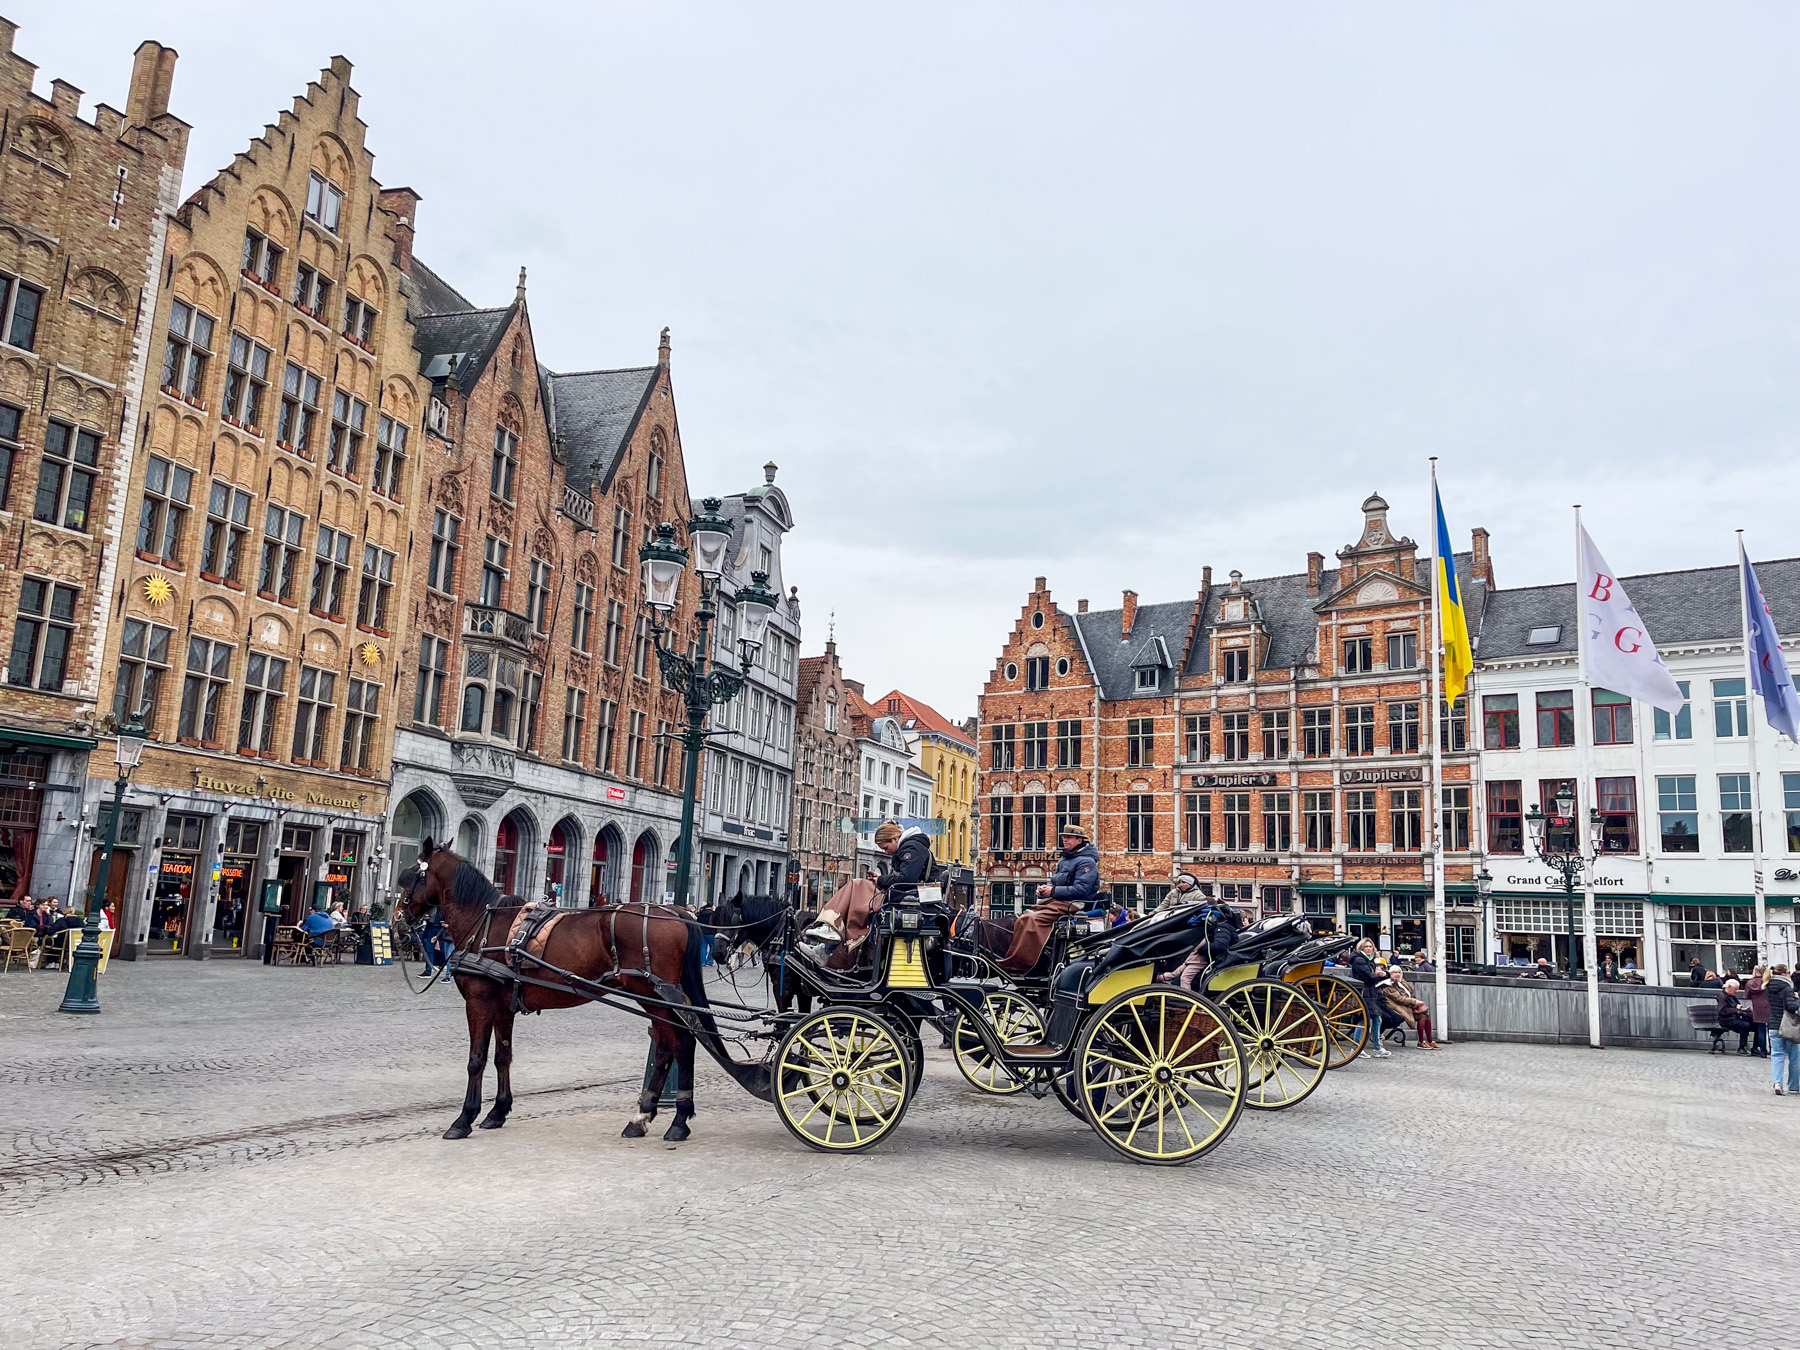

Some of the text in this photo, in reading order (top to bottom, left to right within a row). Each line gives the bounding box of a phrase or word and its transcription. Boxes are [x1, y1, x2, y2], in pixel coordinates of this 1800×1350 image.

[1588, 572, 1613, 602] B
[1614, 626, 1643, 654] G
[1211, 774, 1256, 788] Jupiler
[1356, 768, 1407, 783] Jupiler
[195, 775, 360, 809] Huyze die Maene
[743, 825, 756, 837] fnac
[1003, 852, 1061, 861] DE BEURZE
[1225, 856, 1271, 864] SPORTMAN
[221, 867, 243, 878] RASSERIE
[1507, 875, 1541, 885] Grand
[1593, 876, 1624, 886] elfort
